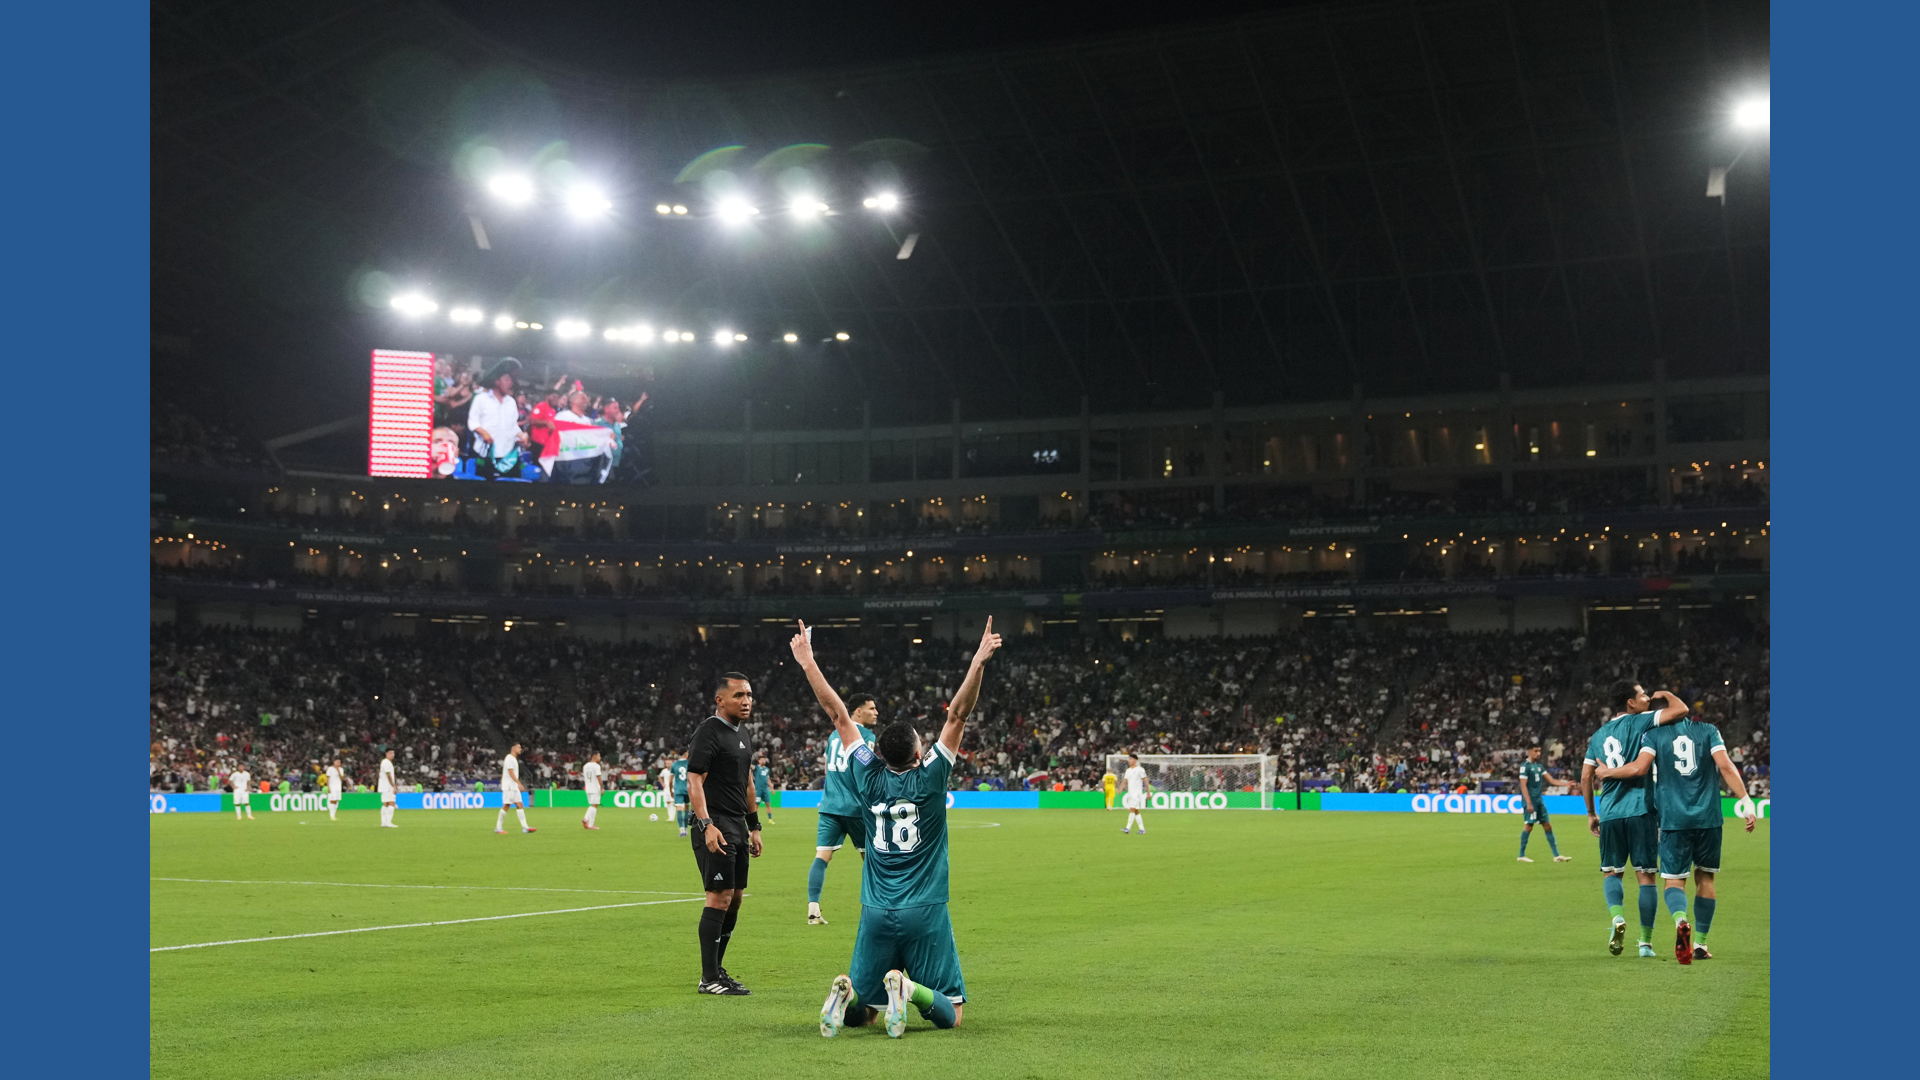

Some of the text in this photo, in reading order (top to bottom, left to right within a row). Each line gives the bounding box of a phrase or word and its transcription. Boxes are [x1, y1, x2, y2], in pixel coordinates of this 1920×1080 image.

[1289, 525, 1381, 536] MONTERREY
[301, 534, 385, 545] MONTERREY
[296, 592, 314, 600] FIFA
[315, 593, 344, 601] WORLD
[362, 595, 390, 604] 2026
[1212, 592, 1234, 600] COPA
[1235, 591, 1273, 599] MUNDIAL
[1275, 590, 1286, 598] DE
[1288, 590, 1299, 598] LA
[1301, 589, 1319, 597] FIFA
[1321, 588, 1351, 597] 2026
[863, 600, 943, 608] MONTERREY
[1603, 735, 1625, 769] 8
[1672, 735, 1697, 776] 9
[678, 766, 687, 781] 3
[422, 793, 484, 809] aramco
[1411, 794, 1524, 813] aramco
[869, 800, 921, 852] 18
